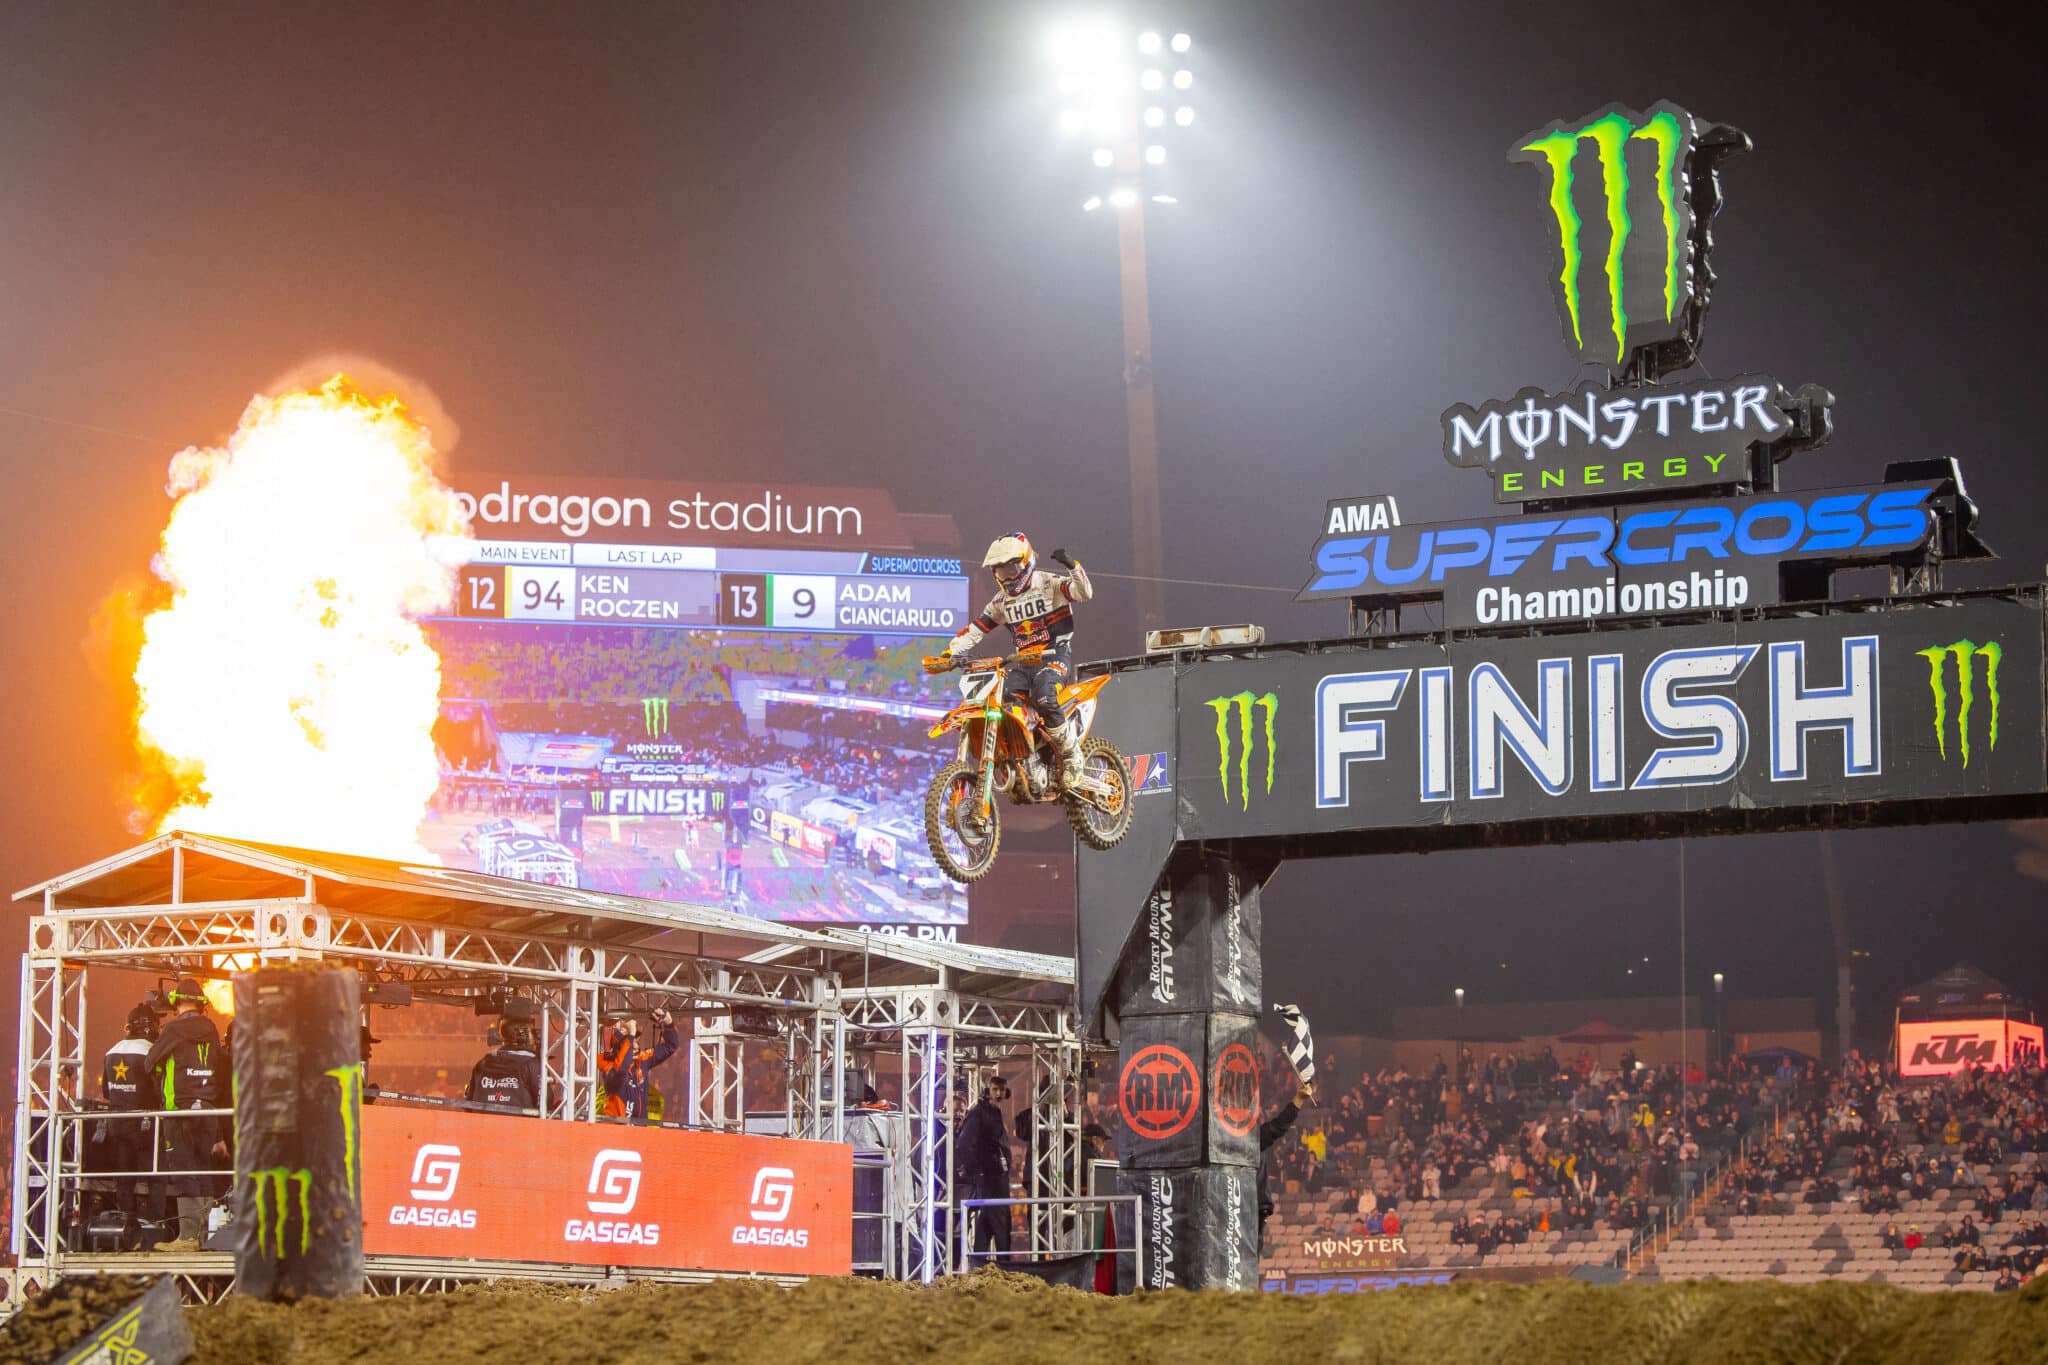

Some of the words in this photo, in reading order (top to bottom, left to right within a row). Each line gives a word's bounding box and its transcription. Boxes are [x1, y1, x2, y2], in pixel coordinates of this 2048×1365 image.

[1451, 385, 1779, 461] MONSTER
[1503, 453, 1727, 492] ENERGY
[668, 490, 862, 535] stadium
[1328, 503, 1390, 534] AMA
[480, 547, 518, 560] MAIN
[522, 548, 568, 561] EVENT
[1308, 489, 1932, 591] SUPERCROSS
[607, 550, 647, 563] LAST
[651, 551, 682, 564] LAP
[871, 556, 961, 575] SUPERMOTOCROSS
[468, 576, 496, 610] 12
[523, 579, 565, 611] 94
[581, 575, 629, 594] KEN
[839, 583, 911, 602] ADAM
[1476, 569, 1748, 624] Championship
[581, 599, 679, 619] ROCZEN
[730, 585, 757, 618] 13
[792, 588, 816, 618] 9
[1006, 599, 1047, 621] THOR
[839, 607, 954, 628] CIANCIARULO
[967, 673, 996, 700] 7
[1315, 635, 1881, 808] FINISH
[609, 789, 706, 813] FINISH
[918, 926, 957, 944] PM
[1150, 942, 1161, 983] ROCKY
[1909, 1034, 1997, 1066] KTM
[1135, 1073, 1184, 1111] RM
[389, 1205, 477, 1228] GASGAS
[1152, 1177, 1161, 1245] MOUNTAIN
[564, 1219, 660, 1245] GASGAS
[732, 1226, 808, 1248] GASGAS
[1304, 1237, 1408, 1257] MONSTER
[1152, 1247, 1162, 1288] ROCKY
[1321, 1259, 1392, 1269] ENERGY
